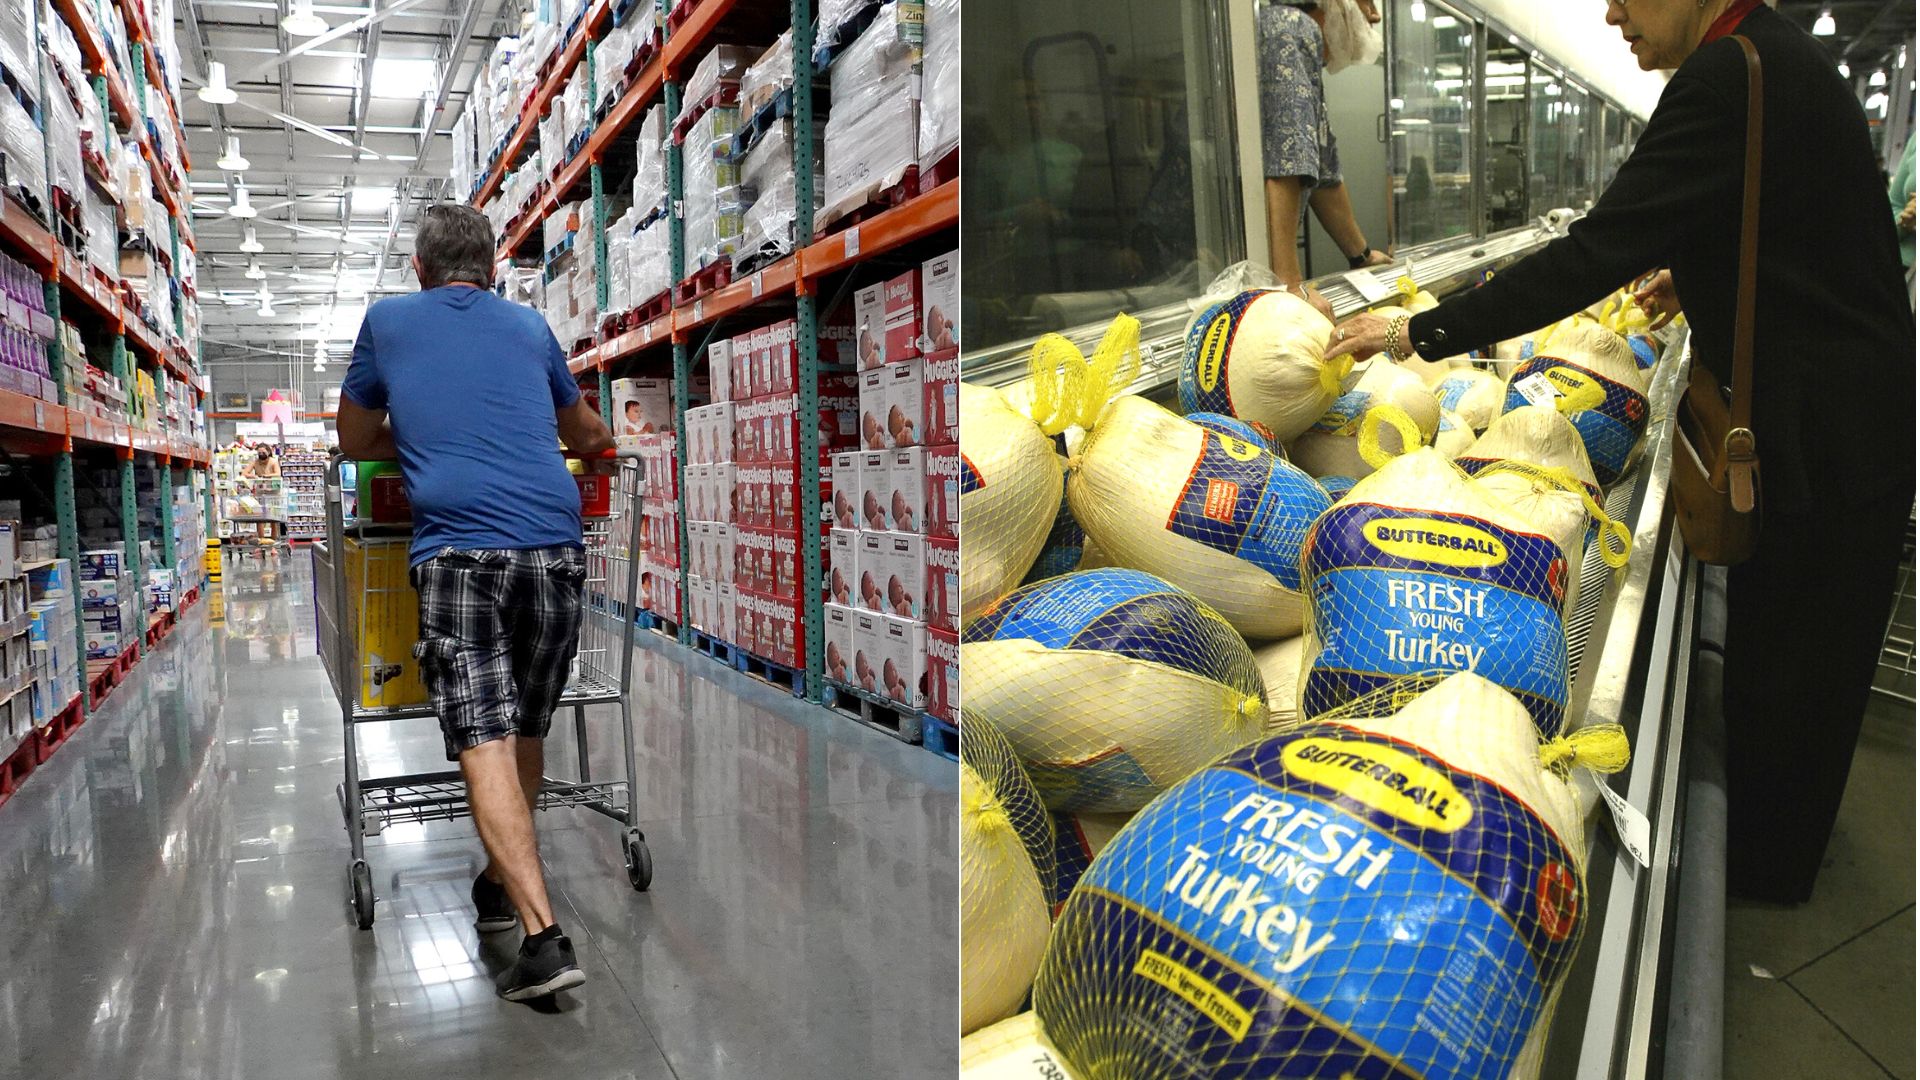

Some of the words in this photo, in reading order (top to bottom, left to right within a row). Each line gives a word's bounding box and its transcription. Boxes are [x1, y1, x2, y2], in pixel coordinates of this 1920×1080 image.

[905, 10, 925, 20] Zin
[924, 357, 959, 384] HUGGIES
[1182, 324, 1204, 382] FRESH
[1203, 318, 1226, 386] BUTTERBALL
[926, 451, 959, 476] HUGGIES
[925, 541, 959, 567] HUGGIES
[1376, 525, 1497, 558] BUTTERBALL
[1387, 579, 1485, 618] FRESH
[1408, 611, 1464, 633] YOUNG
[926, 632, 959, 662] HUGGIES
[1384, 629, 1487, 673] Turkey
[1296, 744, 1453, 821] BUTTERBALL
[1221, 791, 1394, 890] FRESH
[1228, 835, 1326, 895] YOUNG
[1165, 844, 1336, 974] Turkey
[1204, 993, 1243, 1032] Frozen
